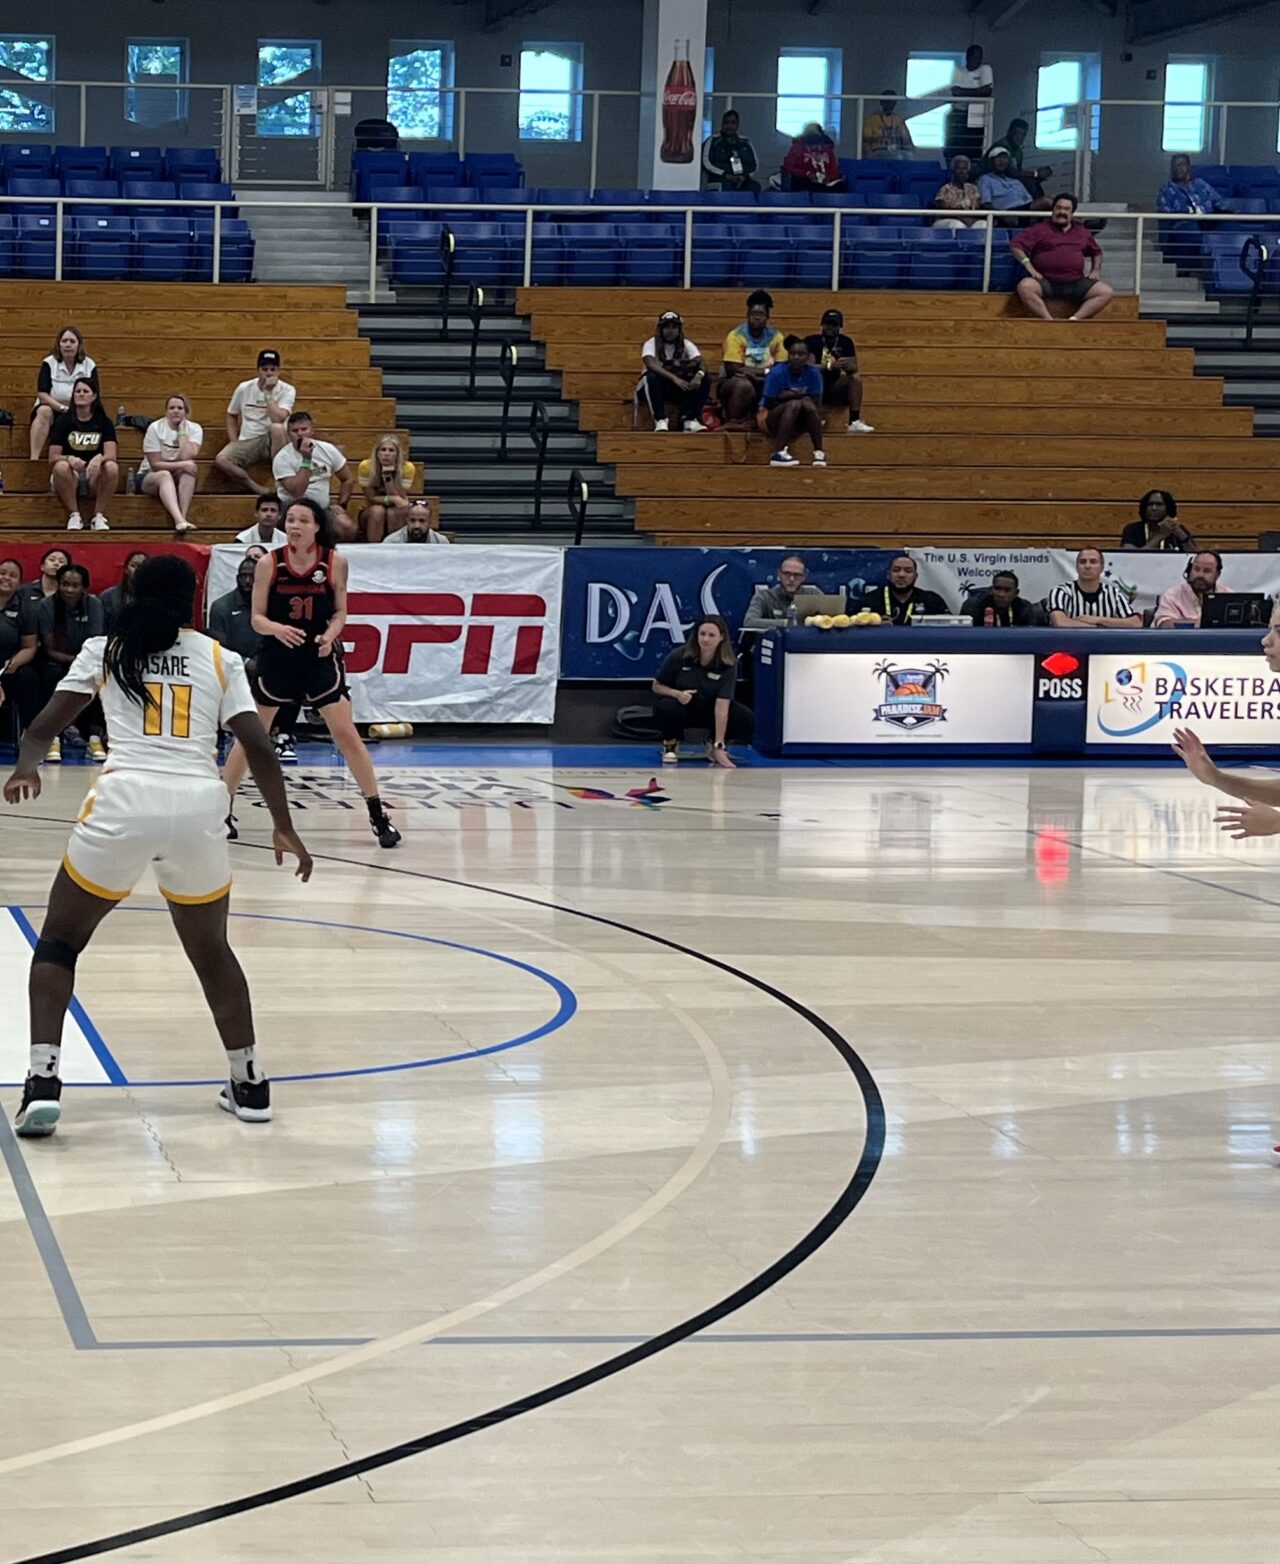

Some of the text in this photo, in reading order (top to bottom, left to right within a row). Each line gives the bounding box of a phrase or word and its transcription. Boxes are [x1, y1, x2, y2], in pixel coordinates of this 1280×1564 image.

[73, 432, 100, 445] VCU
[924, 553, 944, 563] The
[973, 553, 1006, 565] Virgin
[1010, 553, 1050, 563] Islands
[289, 596, 313, 620] 31
[342, 593, 546, 674] SPN
[1039, 678, 1082, 698] POSS
[143, 682, 193, 738] 11
